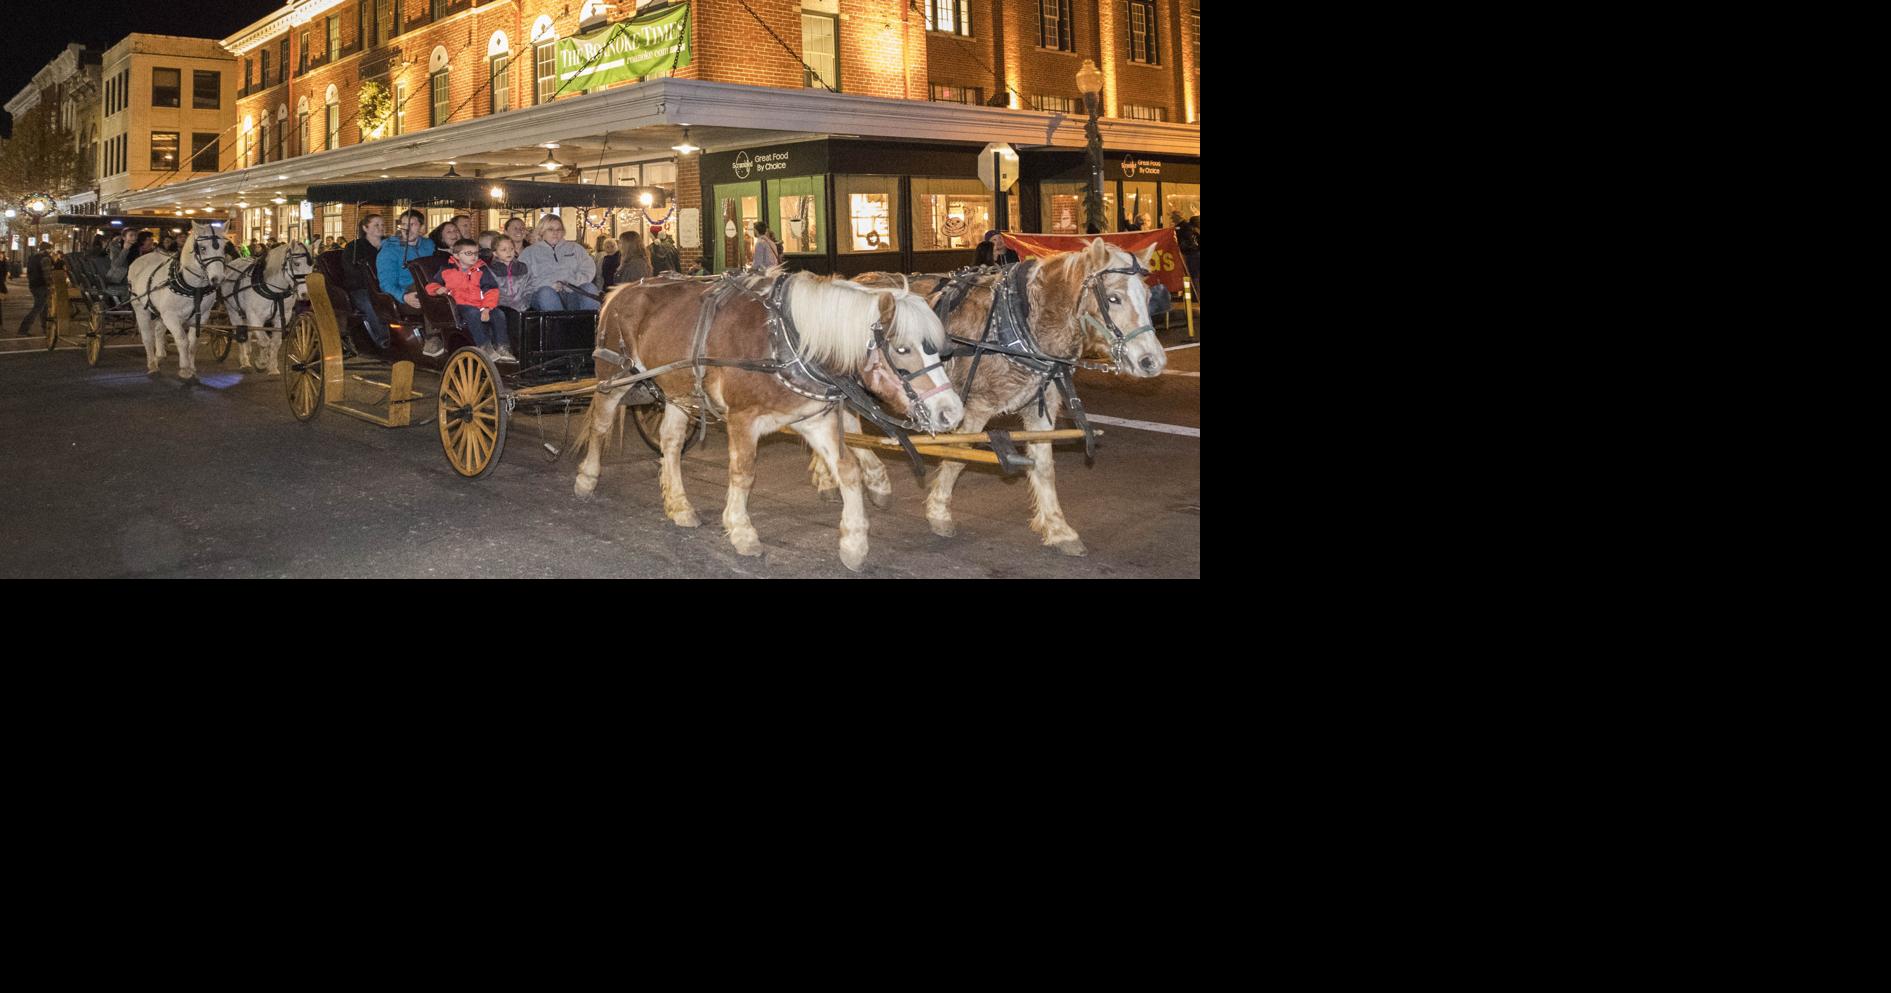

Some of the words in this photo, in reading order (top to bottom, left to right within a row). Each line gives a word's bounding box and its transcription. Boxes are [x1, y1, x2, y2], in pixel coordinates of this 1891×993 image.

[560, 48, 583, 68] THE
[641, 20, 684, 46] TIMES
[754, 154, 772, 162] Great
[773, 151, 789, 160] Food
[757, 163, 765, 172] By
[765, 162, 786, 170] Choice
